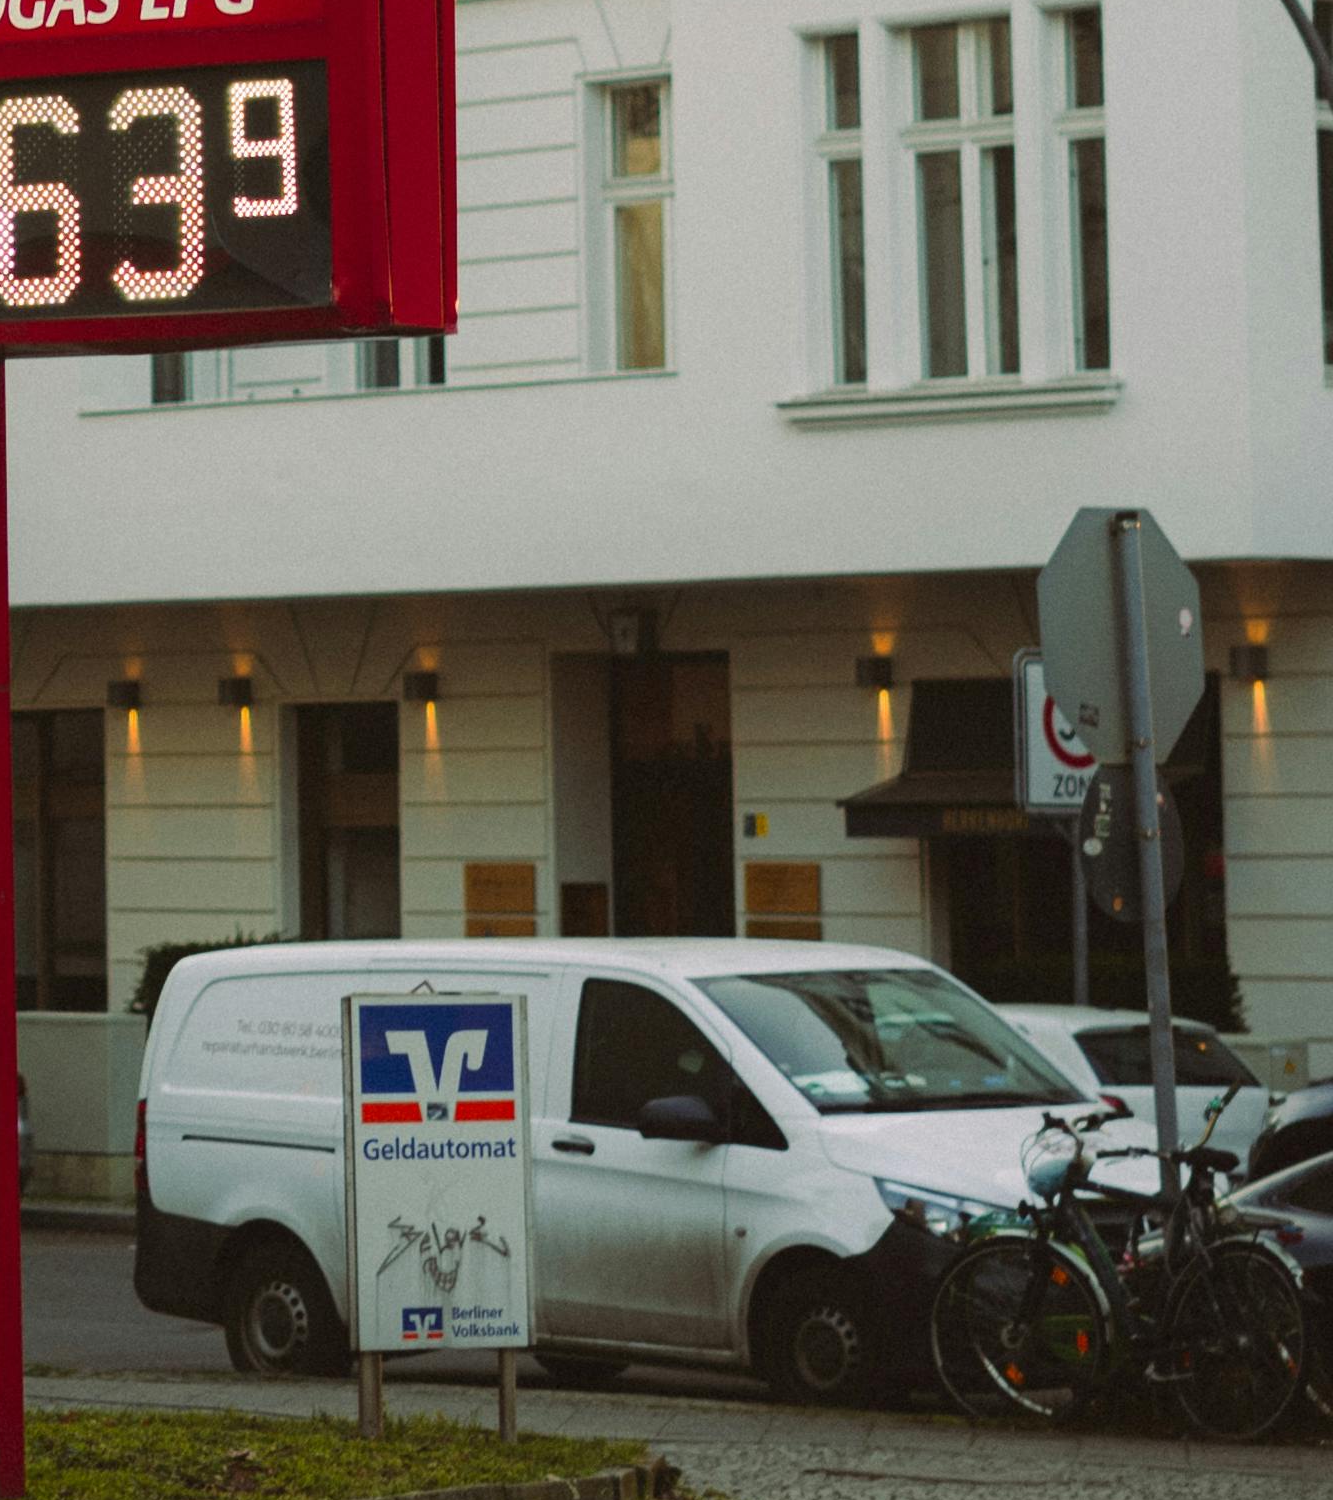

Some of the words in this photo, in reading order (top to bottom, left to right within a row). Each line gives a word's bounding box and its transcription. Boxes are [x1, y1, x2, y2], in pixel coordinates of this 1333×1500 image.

[362, 1136, 517, 1162] Geldautomat
[451, 1305, 504, 1320] Berliner
[451, 1321, 521, 1339] Volksbank
